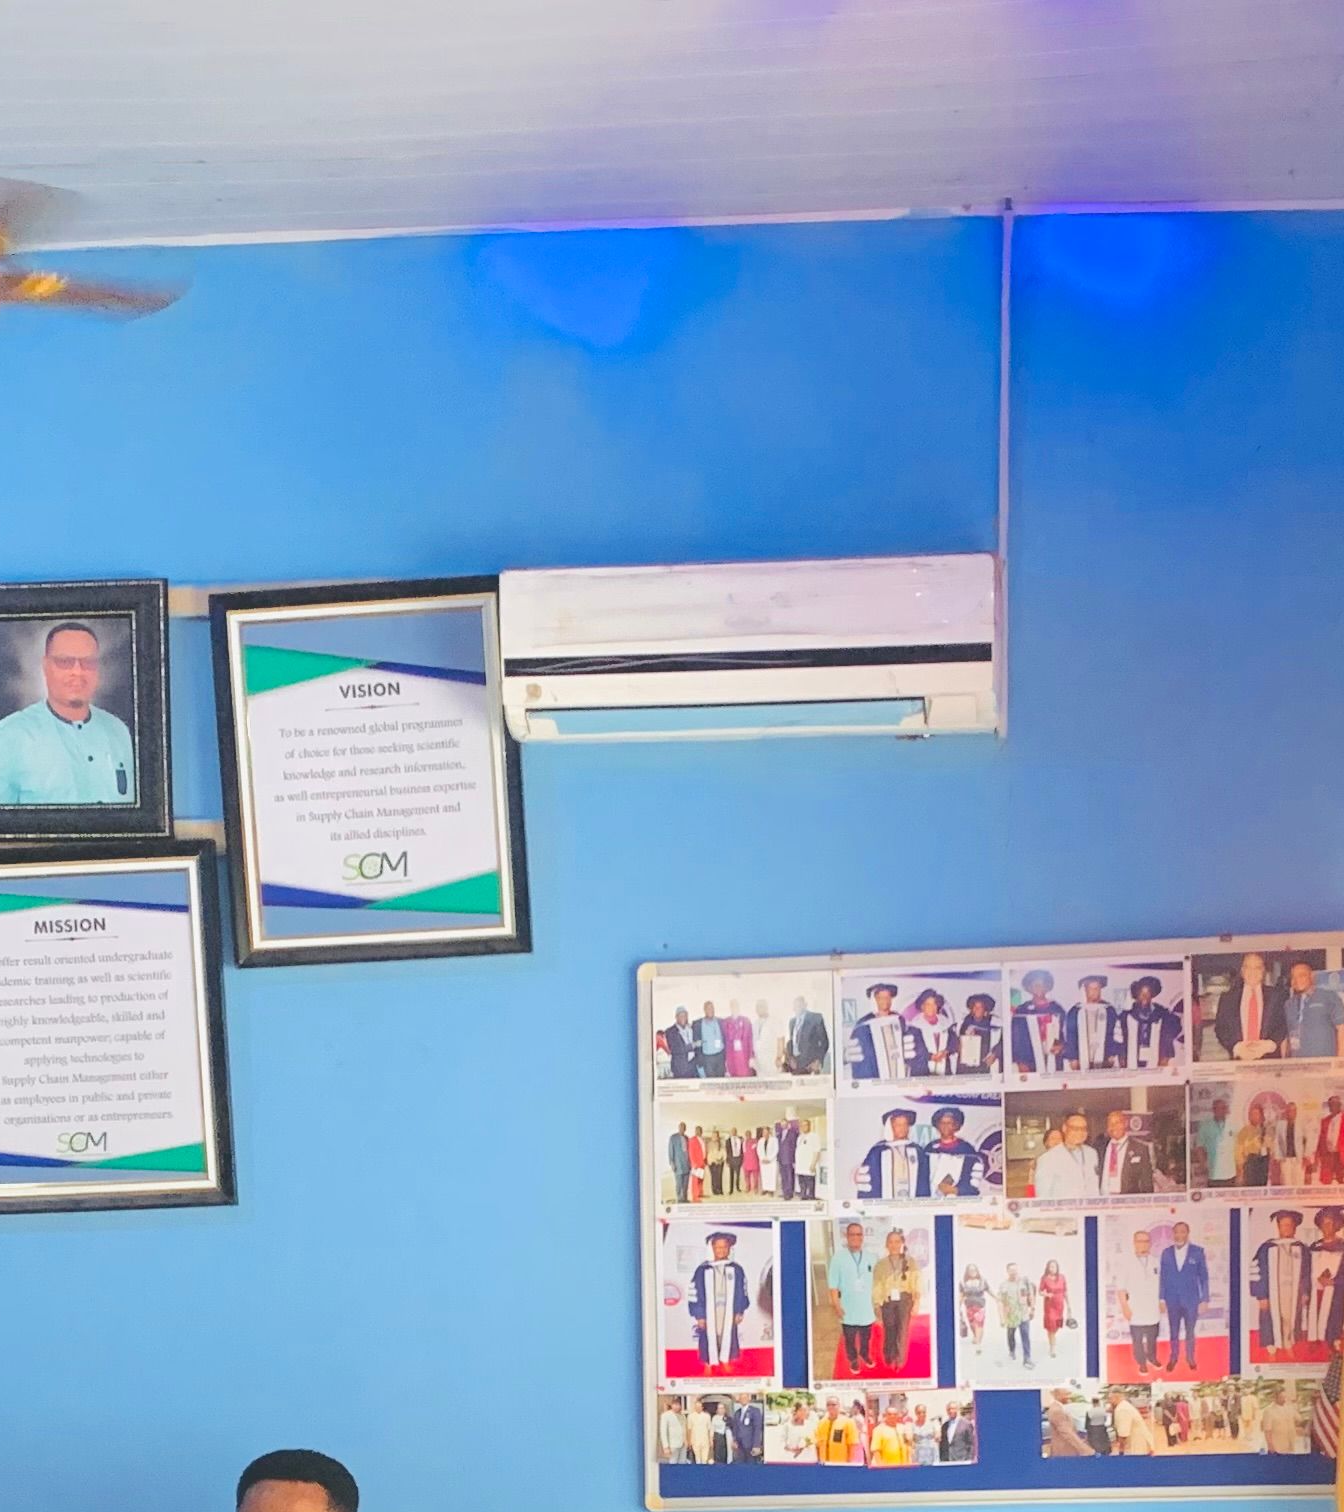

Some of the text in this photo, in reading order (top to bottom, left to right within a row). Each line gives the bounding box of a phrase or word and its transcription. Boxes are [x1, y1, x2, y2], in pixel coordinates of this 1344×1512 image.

[339, 682, 400, 699] VISION
[279, 728, 292, 738] To
[294, 728, 306, 737] be
[309, 729, 314, 737] a
[318, 723, 366, 736] renowned
[369, 721, 398, 736] global
[285, 750, 295, 759] of
[333, 746, 346, 756] for
[417, 739, 459, 751] scientific
[283, 767, 336, 781] knowledge
[339, 766, 357, 777] and
[360, 764, 401, 776] research
[287, 791, 308, 801] well
[296, 802, 461, 824] in Supply Chain Management and
[344, 829, 371, 841] allied
[342, 851, 408, 881] SCM
[34, 918, 106, 934] MISSION
[23, 955, 51, 966] result
[98, 950, 173, 964] undergraduate
[91, 972, 111, 983] well
[128, 971, 172, 981] scientific
[101, 991, 155, 1005] production
[158, 990, 168, 1000] of
[146, 1010, 165, 1020] and
[0, 1035, 51, 1048] competent
[114, 1031, 152, 1043] capable
[155, 1030, 166, 1039] of
[24, 1054, 67, 1067] applying
[2, 1075, 36, 1087] Supply
[39, 1073, 69, 1084] Chain
[72, 1072, 136, 1084] Management
[82, 1093, 113, 1105] public
[116, 1091, 134, 1100] and
[57, 1131, 107, 1153] SCM
